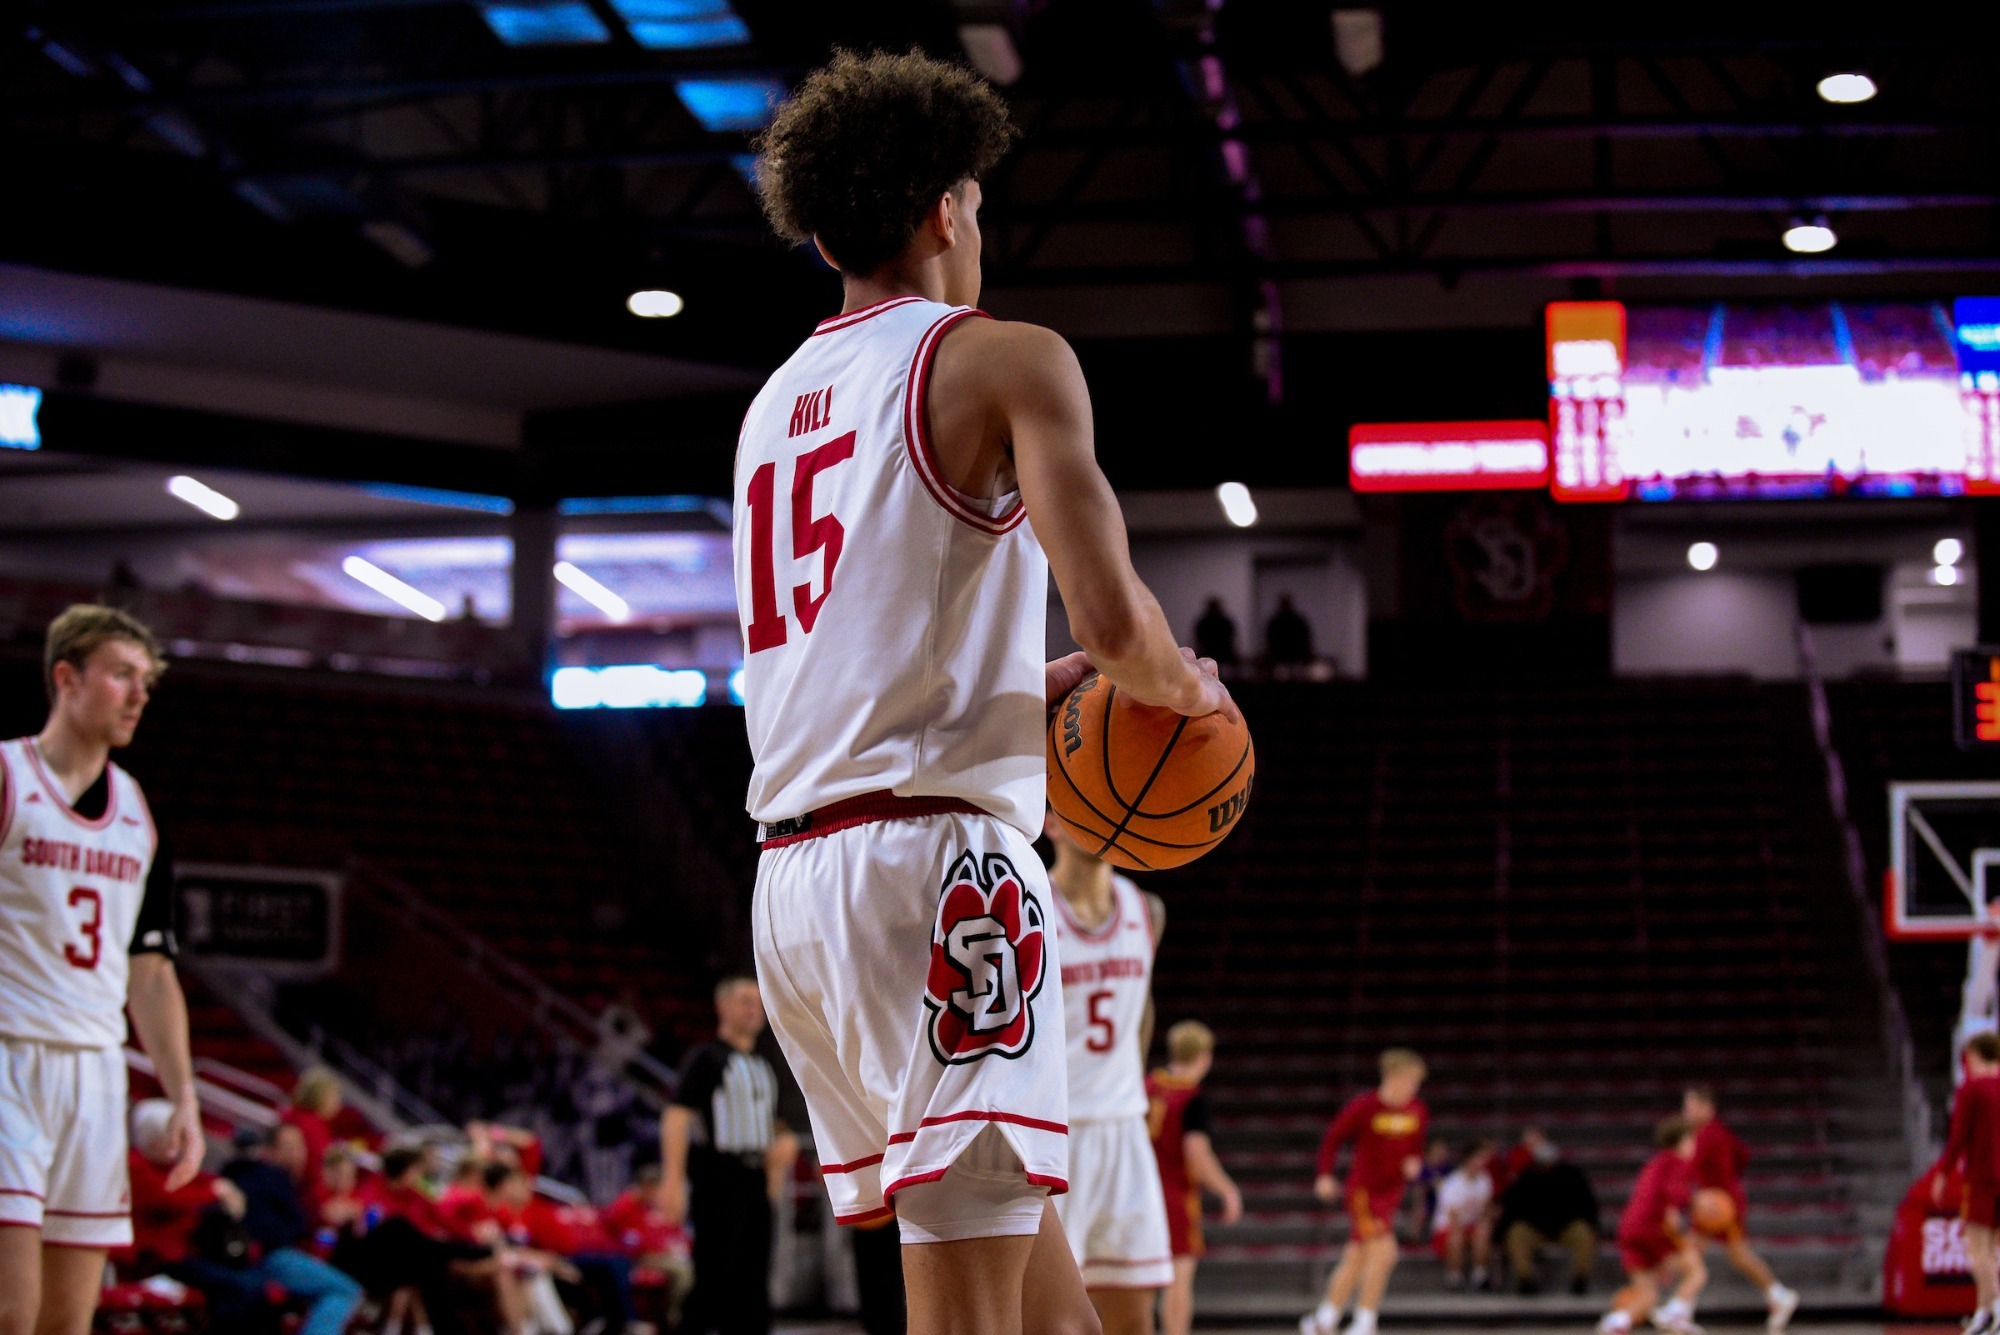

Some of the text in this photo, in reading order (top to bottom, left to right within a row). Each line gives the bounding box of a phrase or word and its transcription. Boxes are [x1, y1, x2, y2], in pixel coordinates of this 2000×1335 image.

[788, 384, 834, 438] HILL
[747, 430, 857, 654] 15
[22, 837, 81, 871] SOUTH
[64, 886, 102, 971] 3
[1085, 989, 1115, 1056] 5
